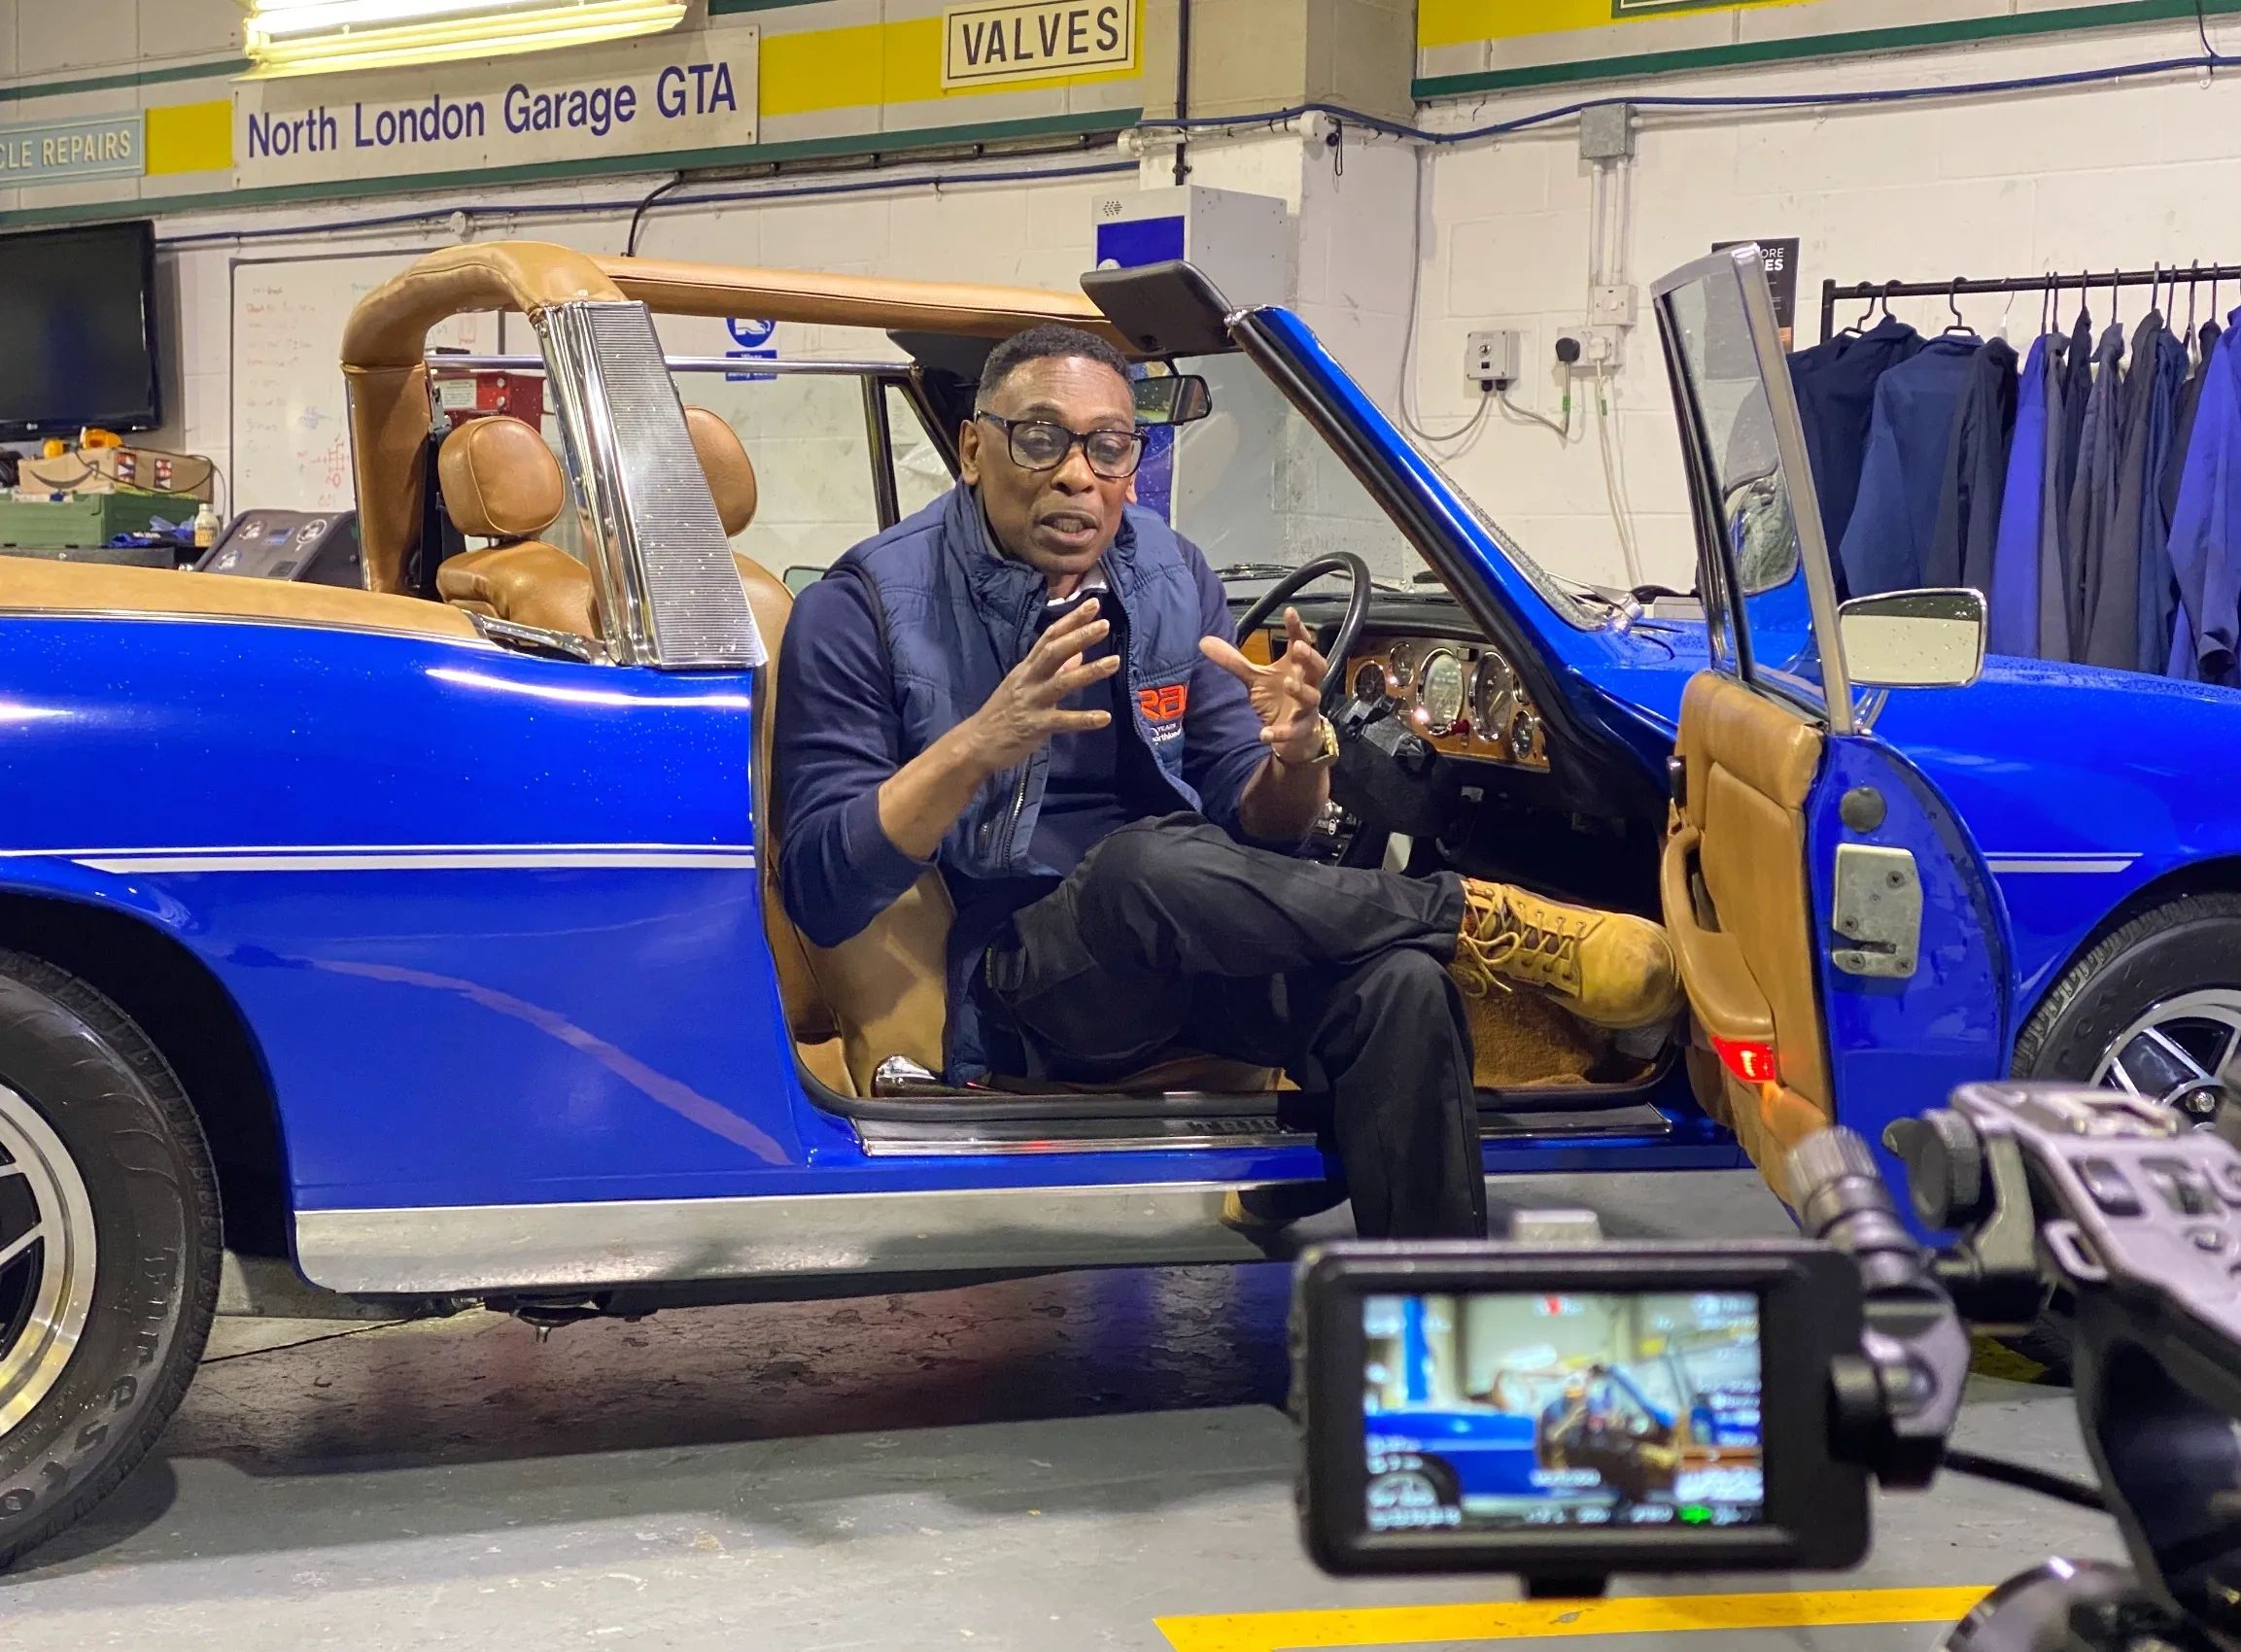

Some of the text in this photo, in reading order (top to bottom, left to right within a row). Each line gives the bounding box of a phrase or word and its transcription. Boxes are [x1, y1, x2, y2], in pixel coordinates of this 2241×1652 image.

[962, 6, 1119, 66] VALVES
[249, 61, 737, 158] North London Garage GTA
[42, 129, 132, 166] REPAIRS
